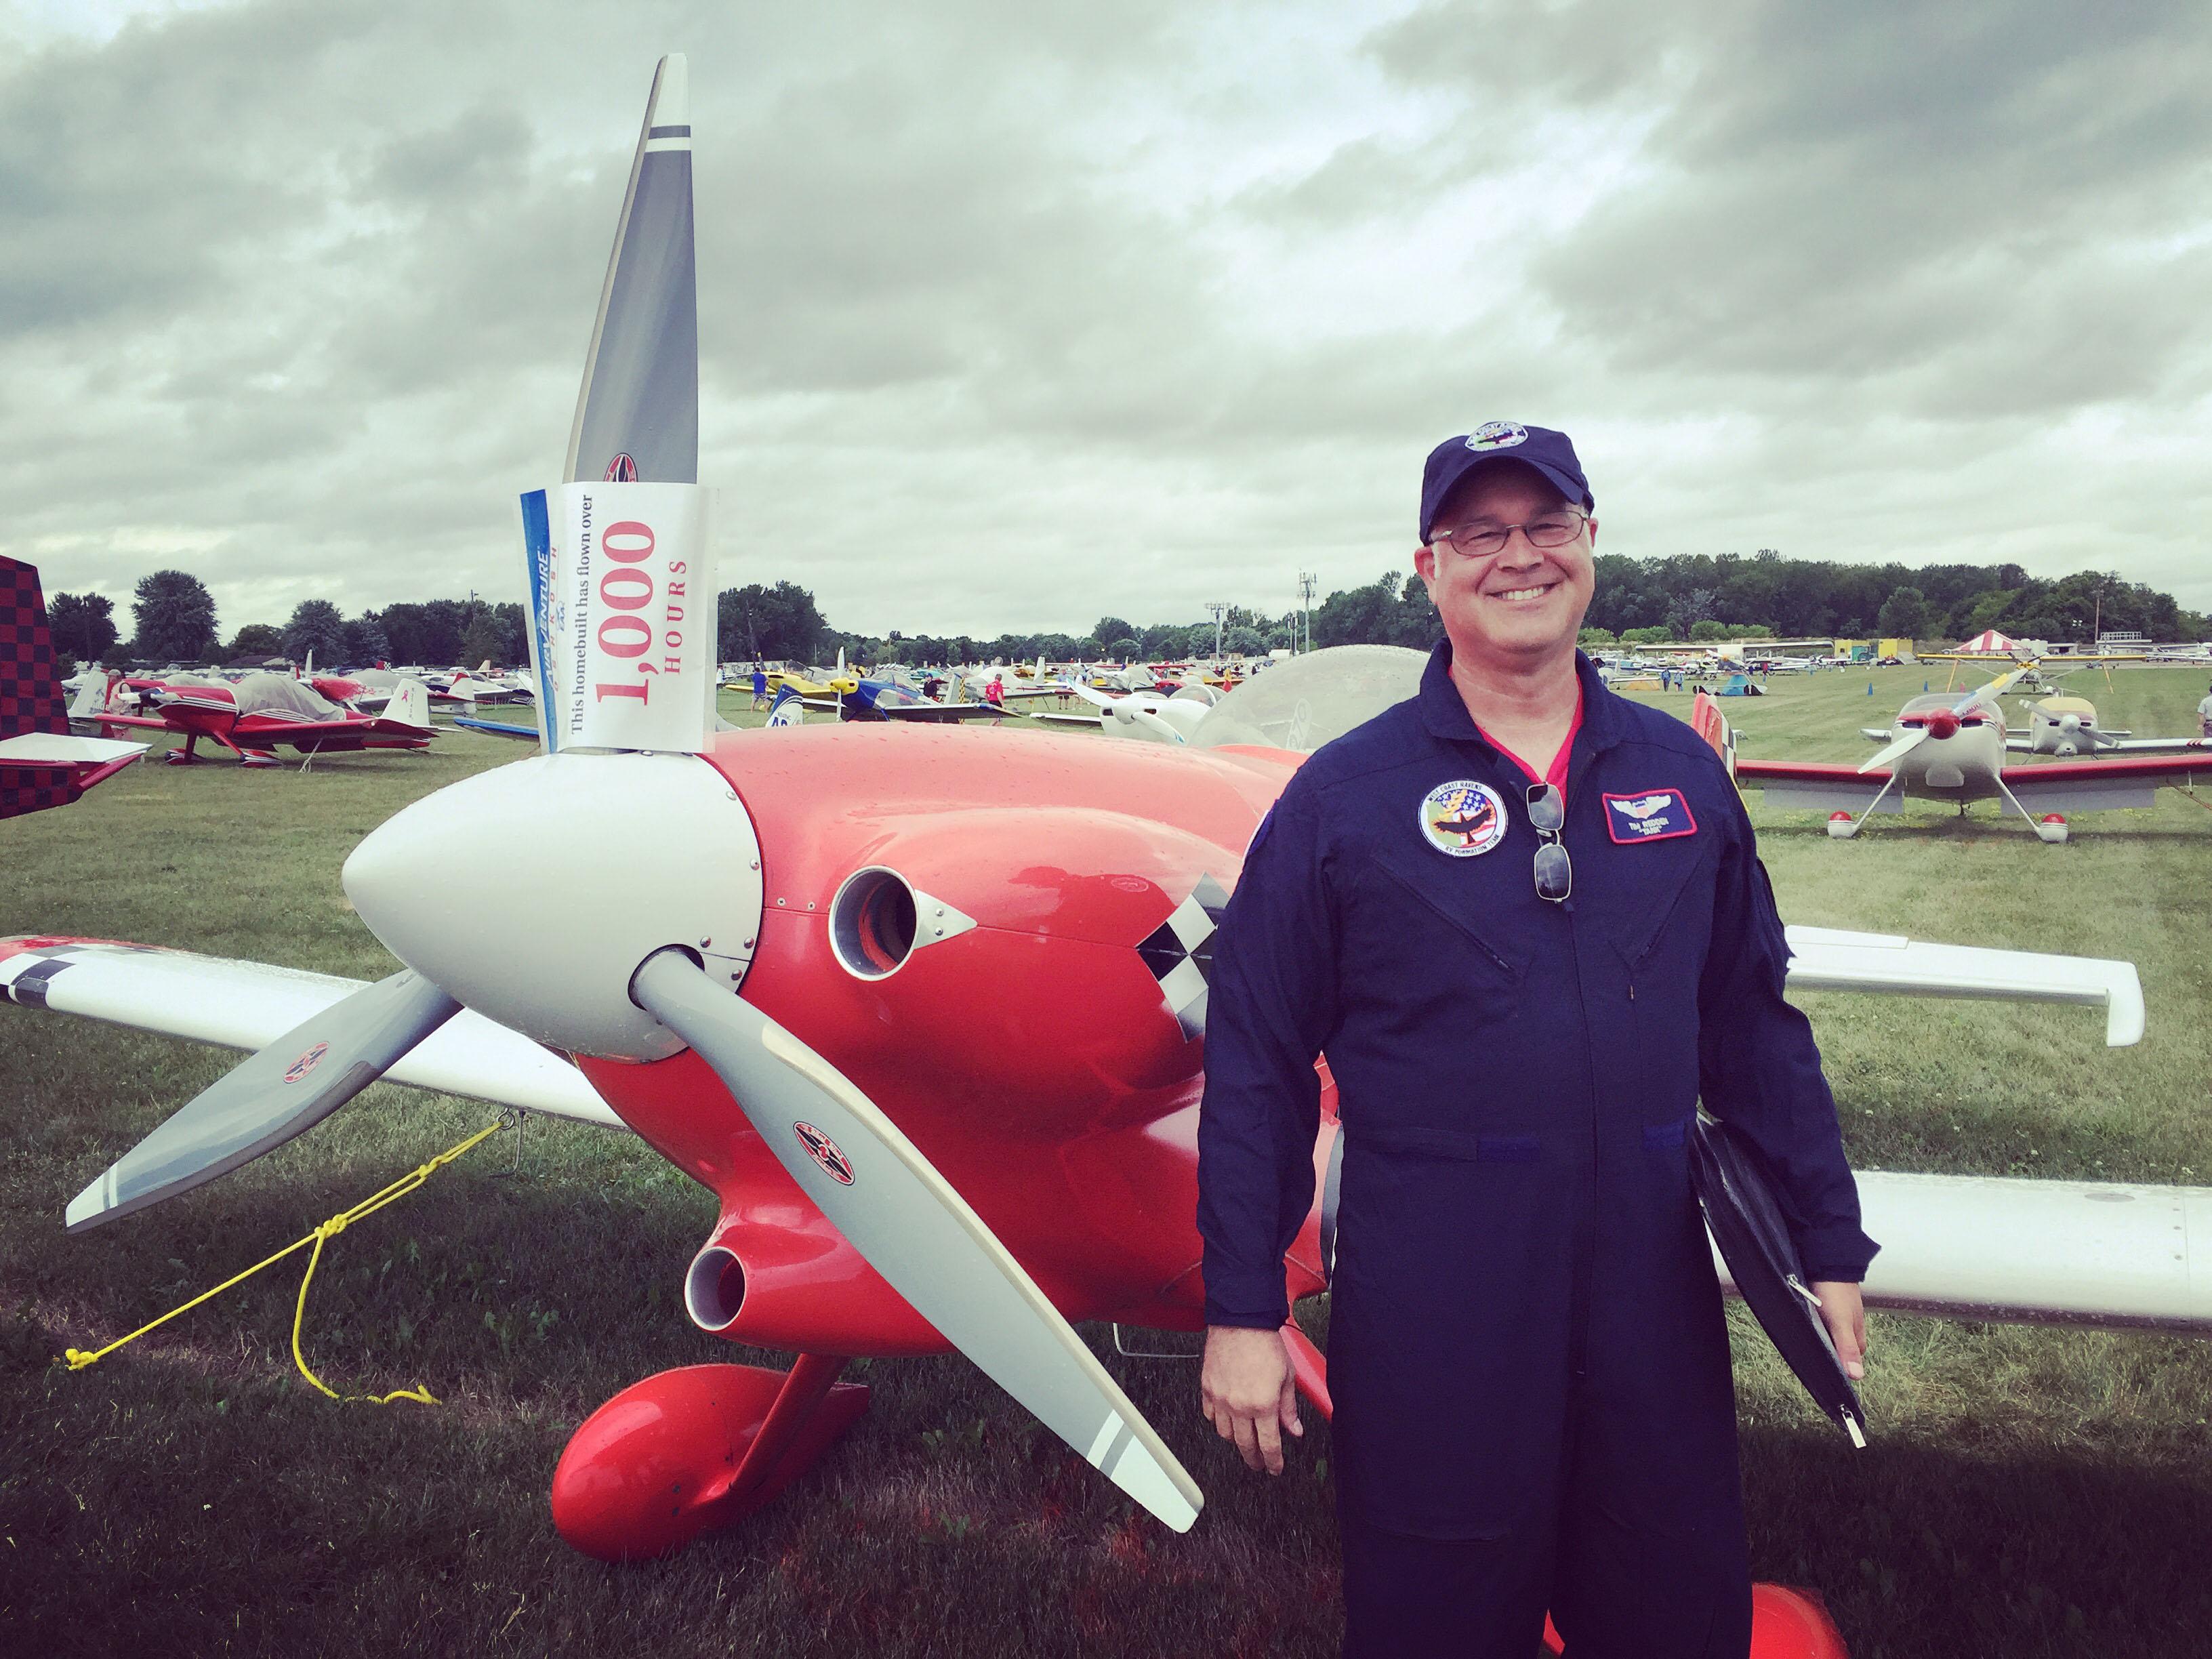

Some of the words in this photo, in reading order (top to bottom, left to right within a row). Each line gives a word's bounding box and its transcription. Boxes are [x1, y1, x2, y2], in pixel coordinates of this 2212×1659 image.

[581, 495, 592, 529] over
[577, 533, 591, 576] flown
[575, 580, 589, 607] has
[596, 520, 659, 705] 1,000
[664, 561, 687, 675] HOURS
[572, 611, 588, 695] homebuilt
[571, 699, 584, 735] This
[1439, 783, 1458, 792] COAST
[1454, 845, 1488, 855] FORMATION
